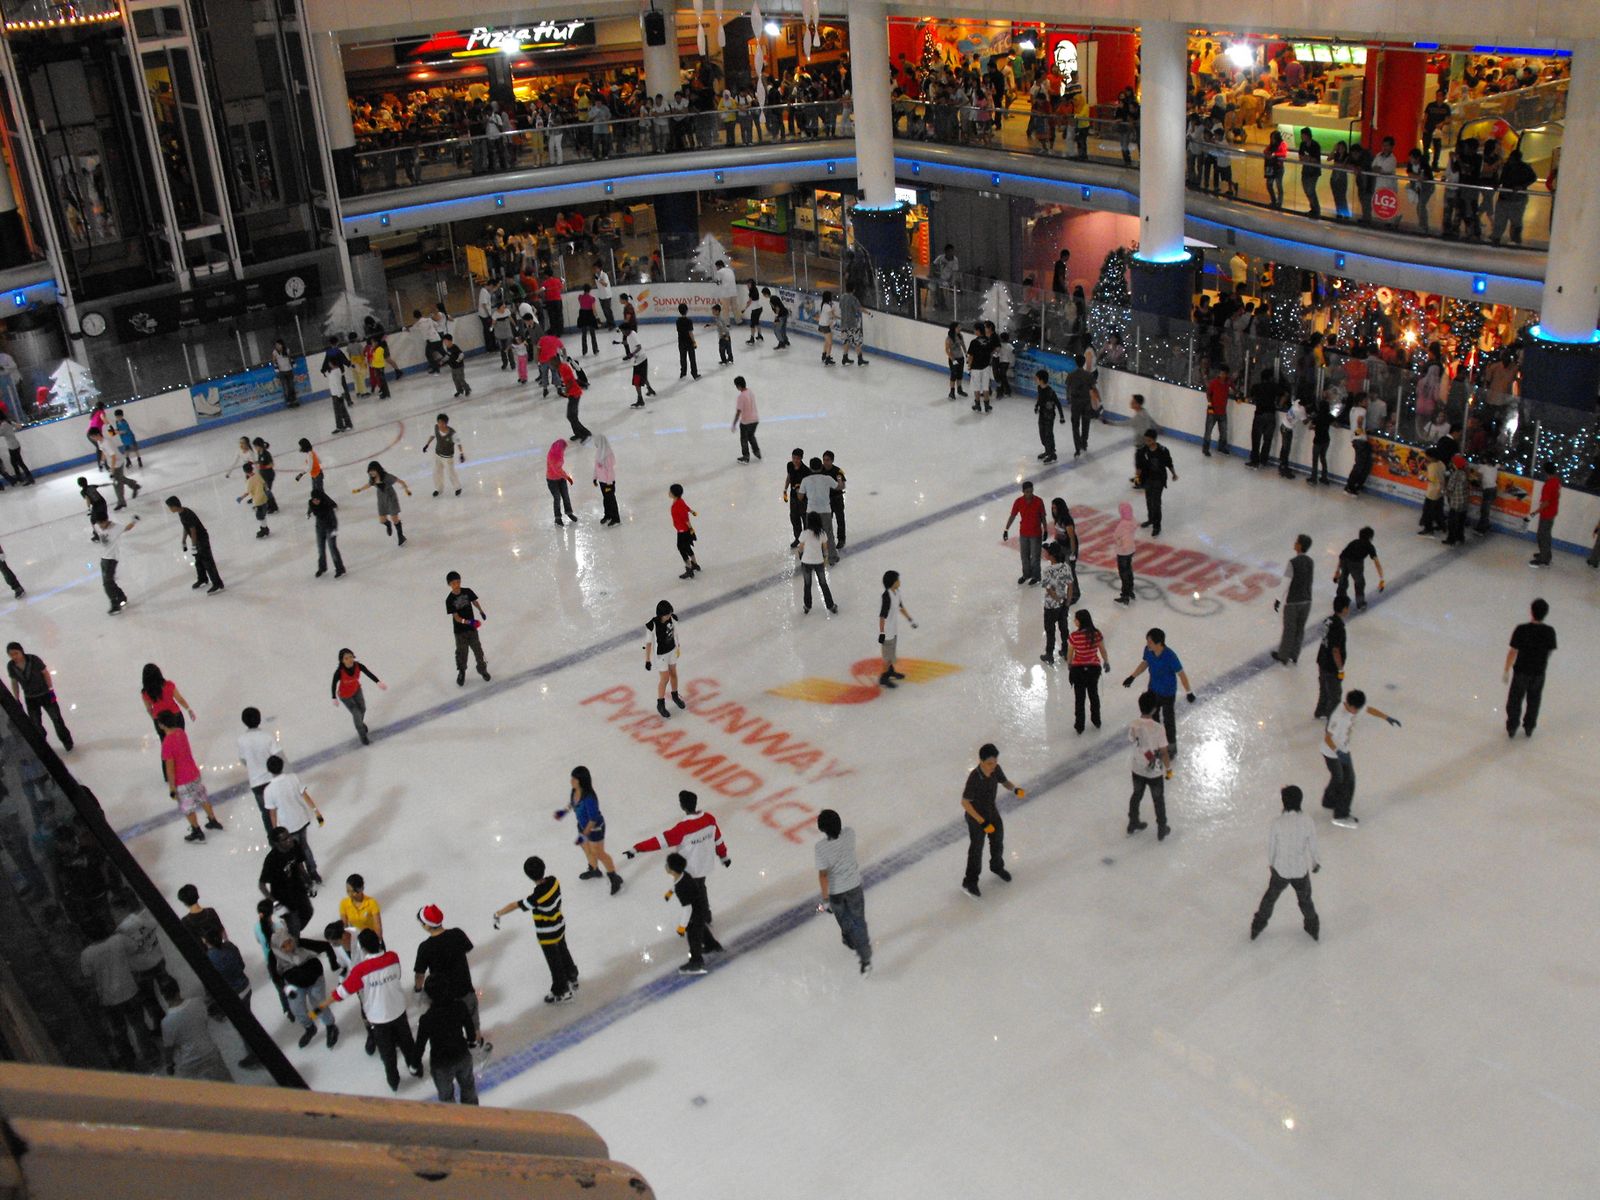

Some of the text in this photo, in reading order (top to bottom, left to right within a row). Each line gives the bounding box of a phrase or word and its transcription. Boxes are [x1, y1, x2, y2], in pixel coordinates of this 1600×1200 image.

[466, 19, 585, 51] Pizza Hut
[1374, 193, 1397, 209] LG2
[578, 684, 765, 798] PYRAMID
[684, 677, 857, 785] SUNWAY
